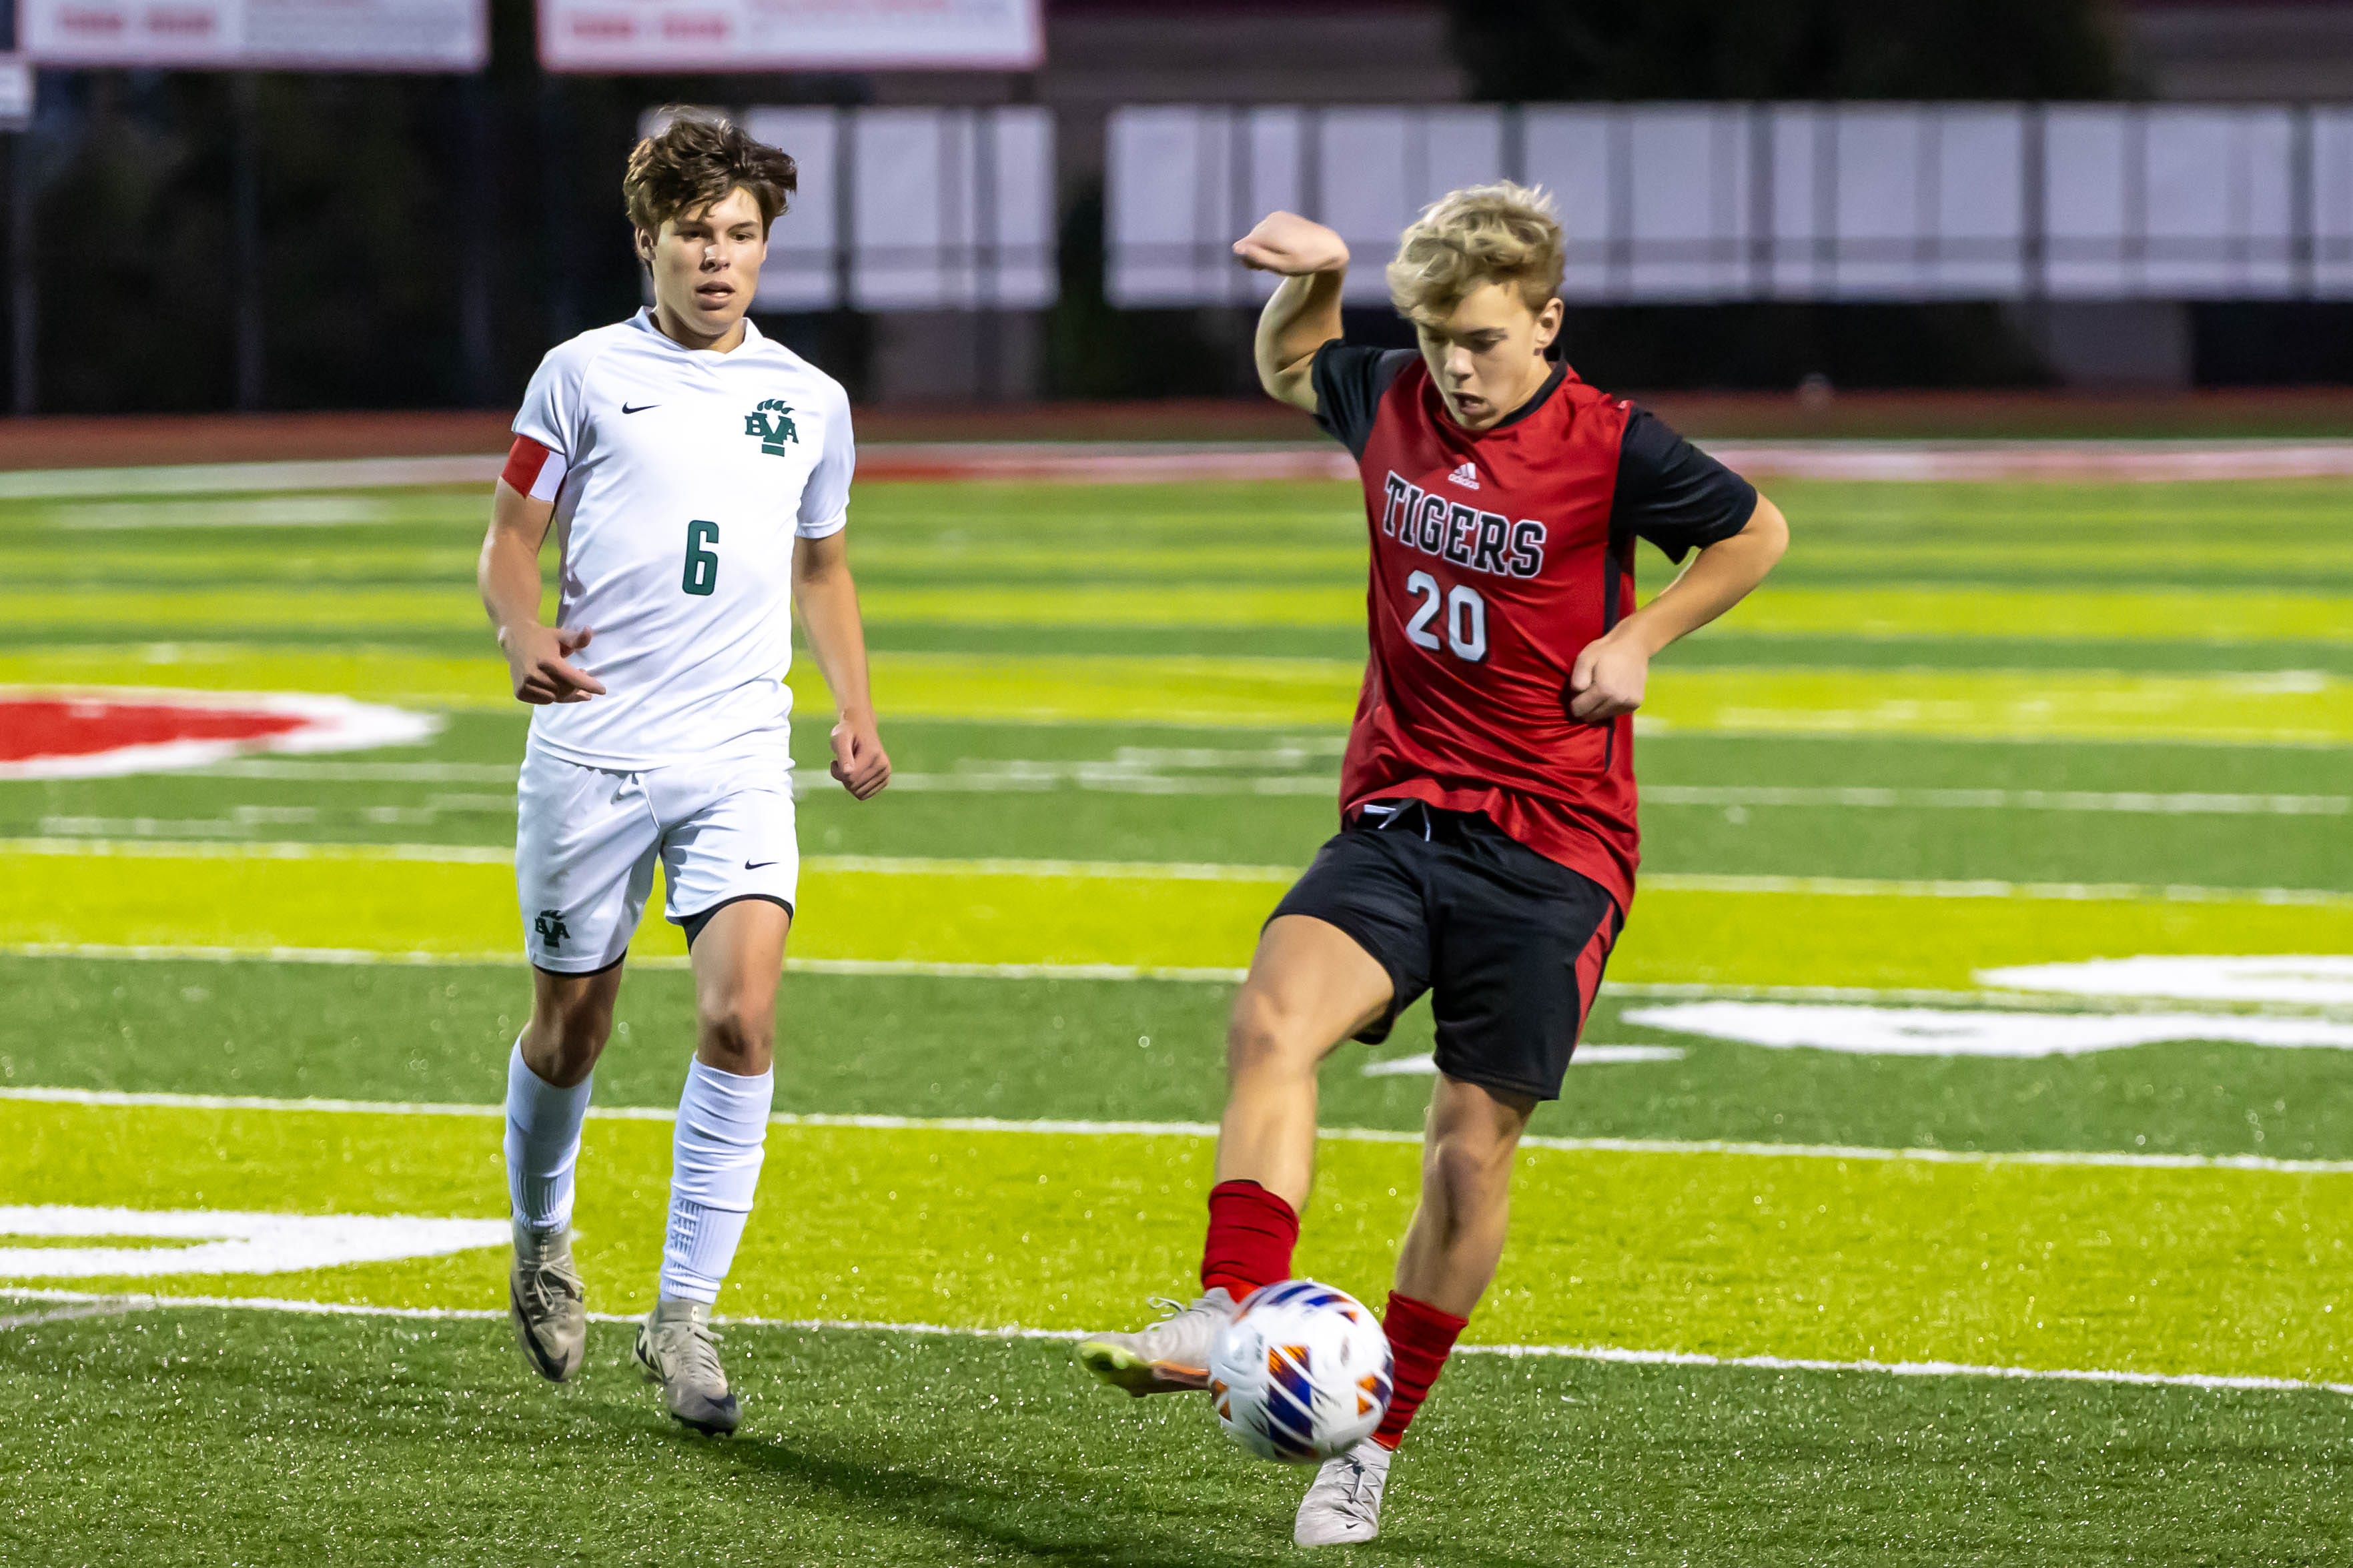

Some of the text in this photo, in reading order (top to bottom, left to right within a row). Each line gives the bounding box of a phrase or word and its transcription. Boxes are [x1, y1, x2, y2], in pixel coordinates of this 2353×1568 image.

[745, 410, 799, 447] BVA
[682, 520, 719, 596] 6
[1383, 470, 1547, 579] TIGERS
[1405, 569, 1488, 662] 20
